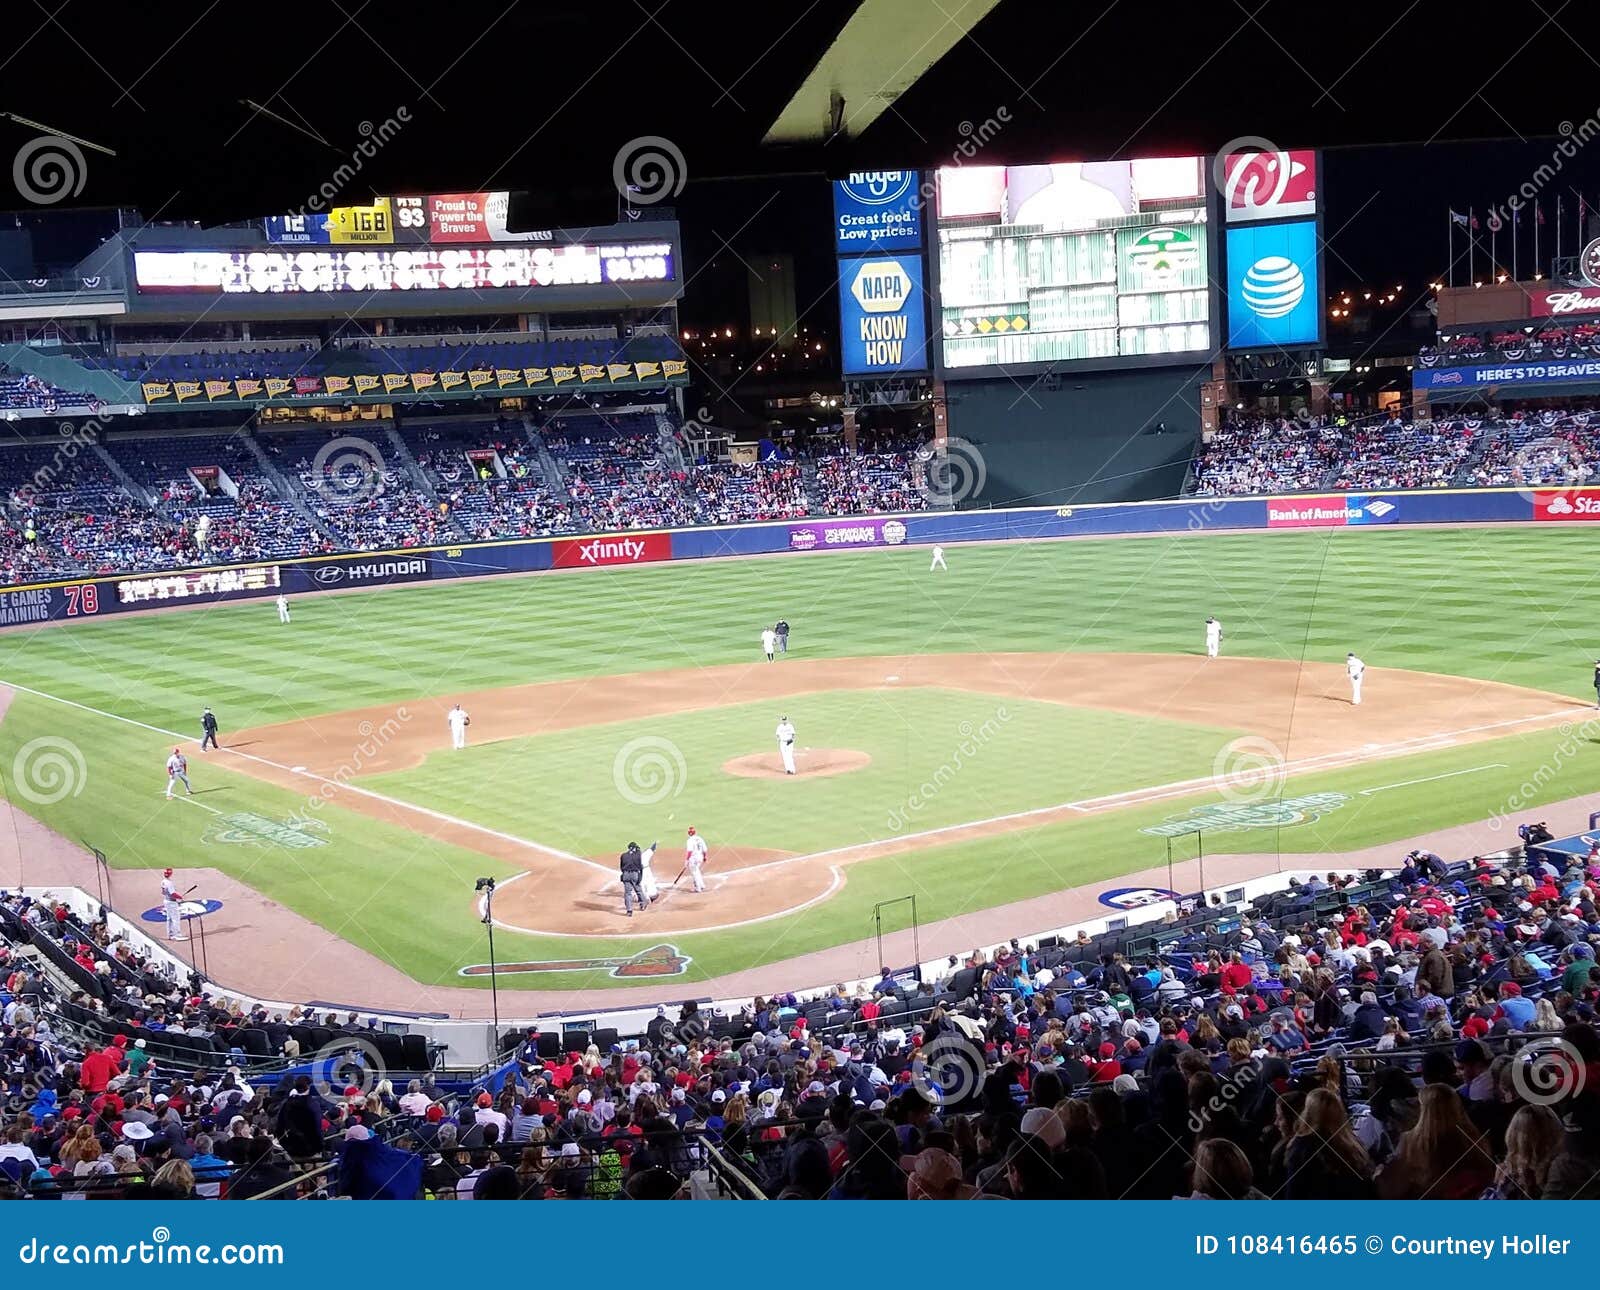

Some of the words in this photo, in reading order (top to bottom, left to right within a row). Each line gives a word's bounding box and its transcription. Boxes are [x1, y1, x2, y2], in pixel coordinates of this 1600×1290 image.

[435, 200, 466, 211] Proud
[468, 200, 478, 211] to
[399, 208, 425, 228] 93
[431, 211, 465, 222] Power
[466, 211, 483, 221] the
[840, 214, 879, 226] Great
[881, 211, 916, 224] food.
[281, 233, 310, 241] MILLION
[350, 233, 379, 242] MILLION
[441, 223, 476, 233] Braves
[839, 228, 868, 240] Low
[871, 226, 918, 241] prices.
[862, 275, 902, 300] NAPA
[860, 315, 908, 341] KNOW
[866, 340, 903, 366] HOW
[1476, 368, 1524, 382] HERE'S
[1526, 367, 1545, 378] TO
[1547, 363, 1600, 377] BRAVES
[1269, 509, 1301, 521] Bank
[1301, 508, 1315, 520] of
[1314, 508, 1363, 520] America
[579, 537, 642, 562] xfinity
[348, 559, 427, 579] HYUNDAI
[11, 588, 52, 607] GAMES
[64, 584, 99, 616] 78
